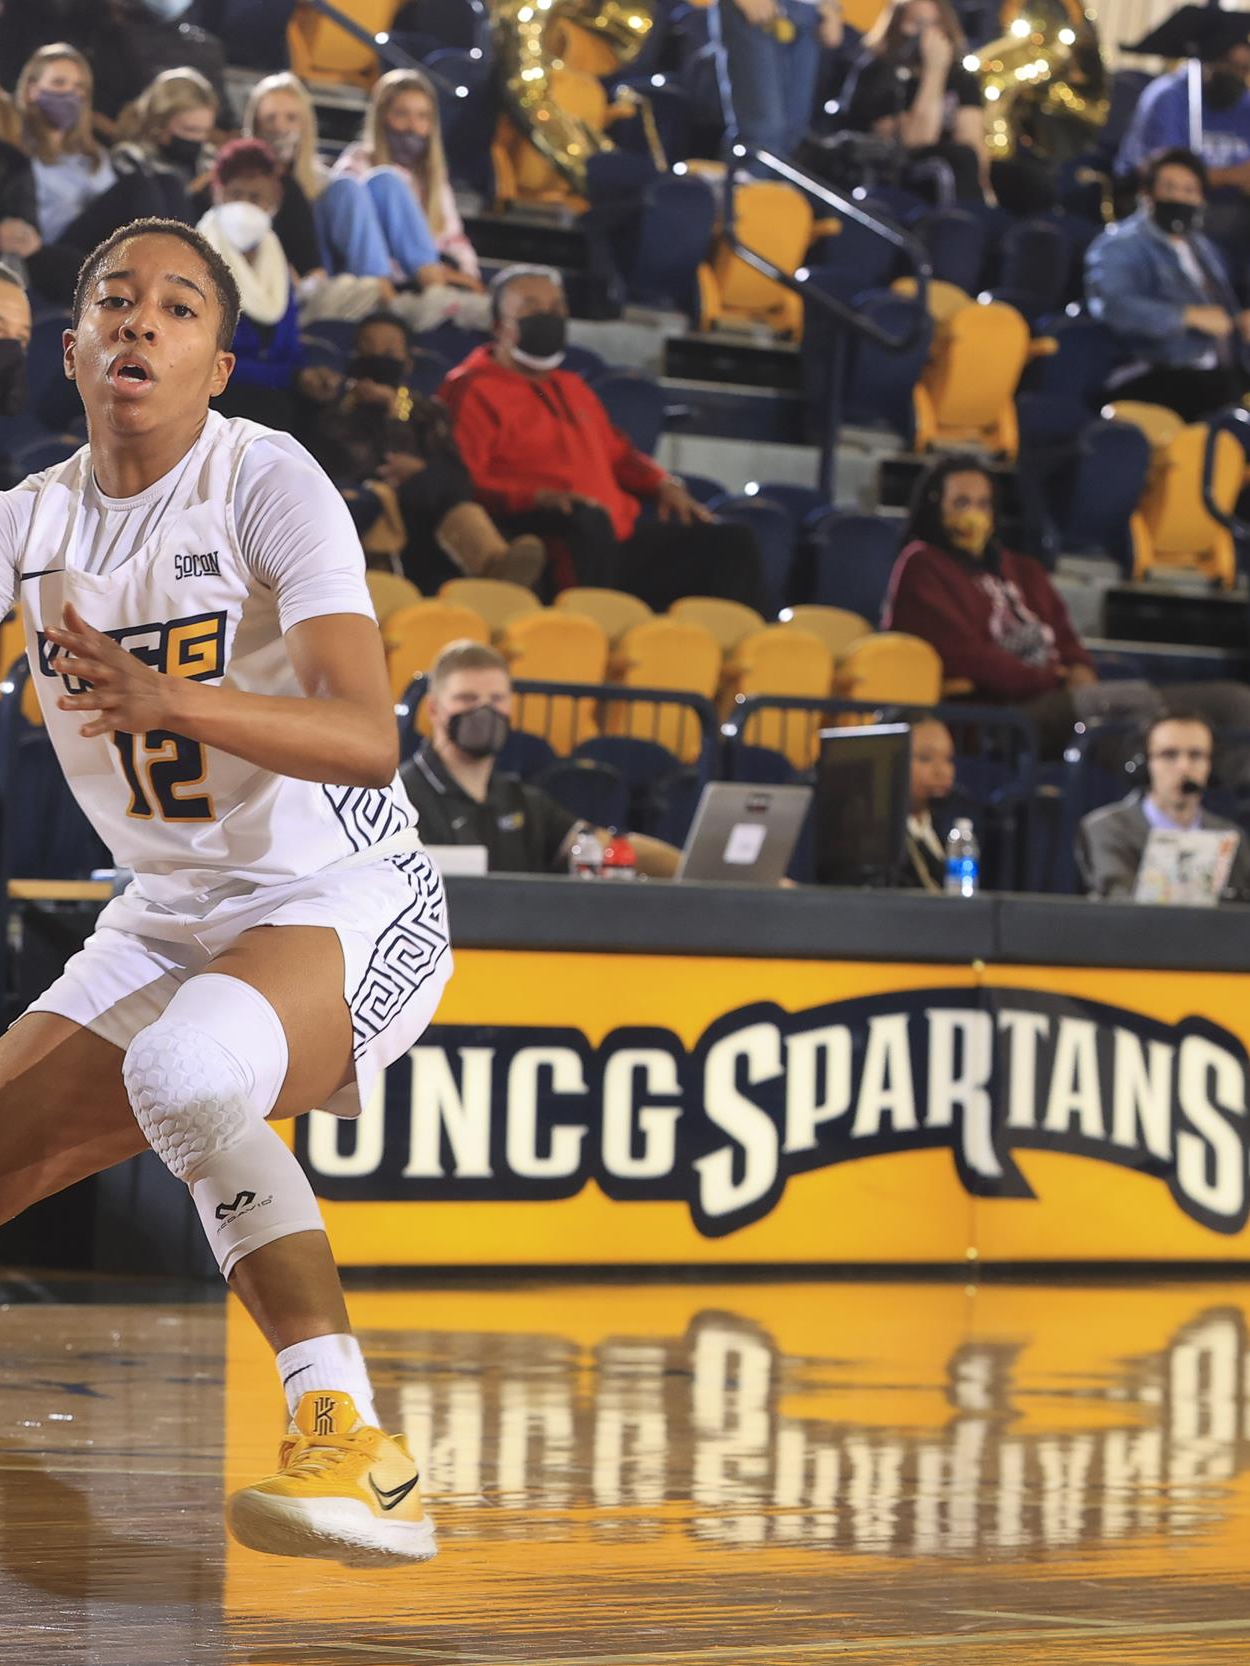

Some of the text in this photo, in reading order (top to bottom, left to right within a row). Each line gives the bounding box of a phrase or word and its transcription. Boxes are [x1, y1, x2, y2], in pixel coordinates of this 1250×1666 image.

[174, 551, 222, 581] SOCON
[36, 610, 228, 694] UCG
[110, 729, 217, 823] 12
[692, 1007, 1248, 1218] SPARTANS
